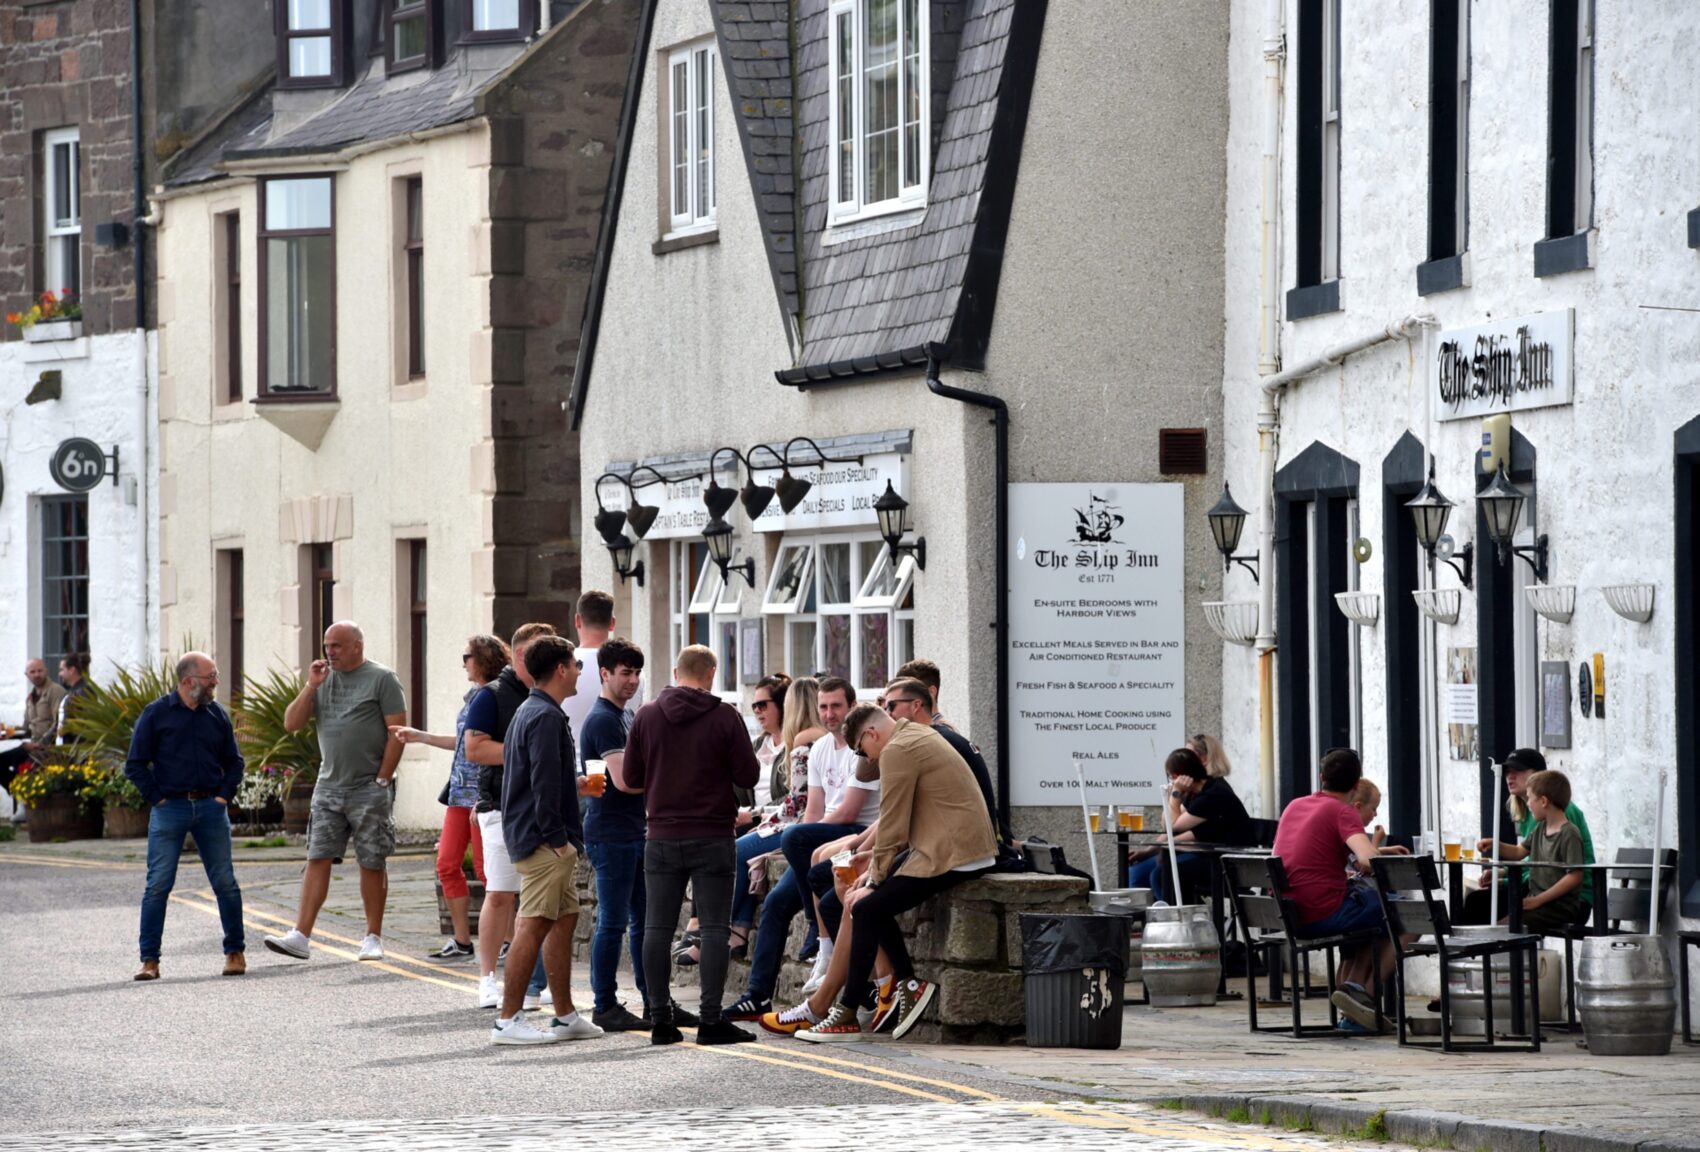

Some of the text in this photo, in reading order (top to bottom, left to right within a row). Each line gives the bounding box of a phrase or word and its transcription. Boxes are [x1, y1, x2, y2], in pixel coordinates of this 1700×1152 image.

[1438, 325, 1553, 414] The Ship Inn
[810, 471, 834, 486] SEAFOOD
[835, 470, 847, 484] OUR
[847, 467, 879, 482] SPECIALITY
[803, 500, 818, 514] DAILY
[819, 498, 845, 513] SPECIALS
[852, 496, 871, 511] LOCAL
[677, 511, 692, 528] TABLE
[1034, 549, 1159, 571] The Ship Inn
[1078, 574, 1115, 583] Est 1771
[1034, 599, 1157, 607] EN-SUITE BEDROOMS WITH
[1057, 609, 1136, 617] HARBOUR VIEWS
[1012, 640, 1179, 649] EXCELLENT MEALS SERVED IN BAR AND
[1029, 653, 1162, 661] AIR CONDITIONED RESTAURANT
[1016, 682, 1174, 690] FRESH FISH & SEAFOOD A SPECIALITY
[1020, 710, 1171, 718] TRADITIONAL HOME COOKING USING
[1035, 723, 1157, 731] THE FINEST LOCAL PRODUCE
[1072, 752, 1119, 760] REAL ALES
[1040, 780, 1063, 789] OVER
[1086, 780, 1108, 789] MALT
[1111, 780, 1152, 789] WHISKIES
